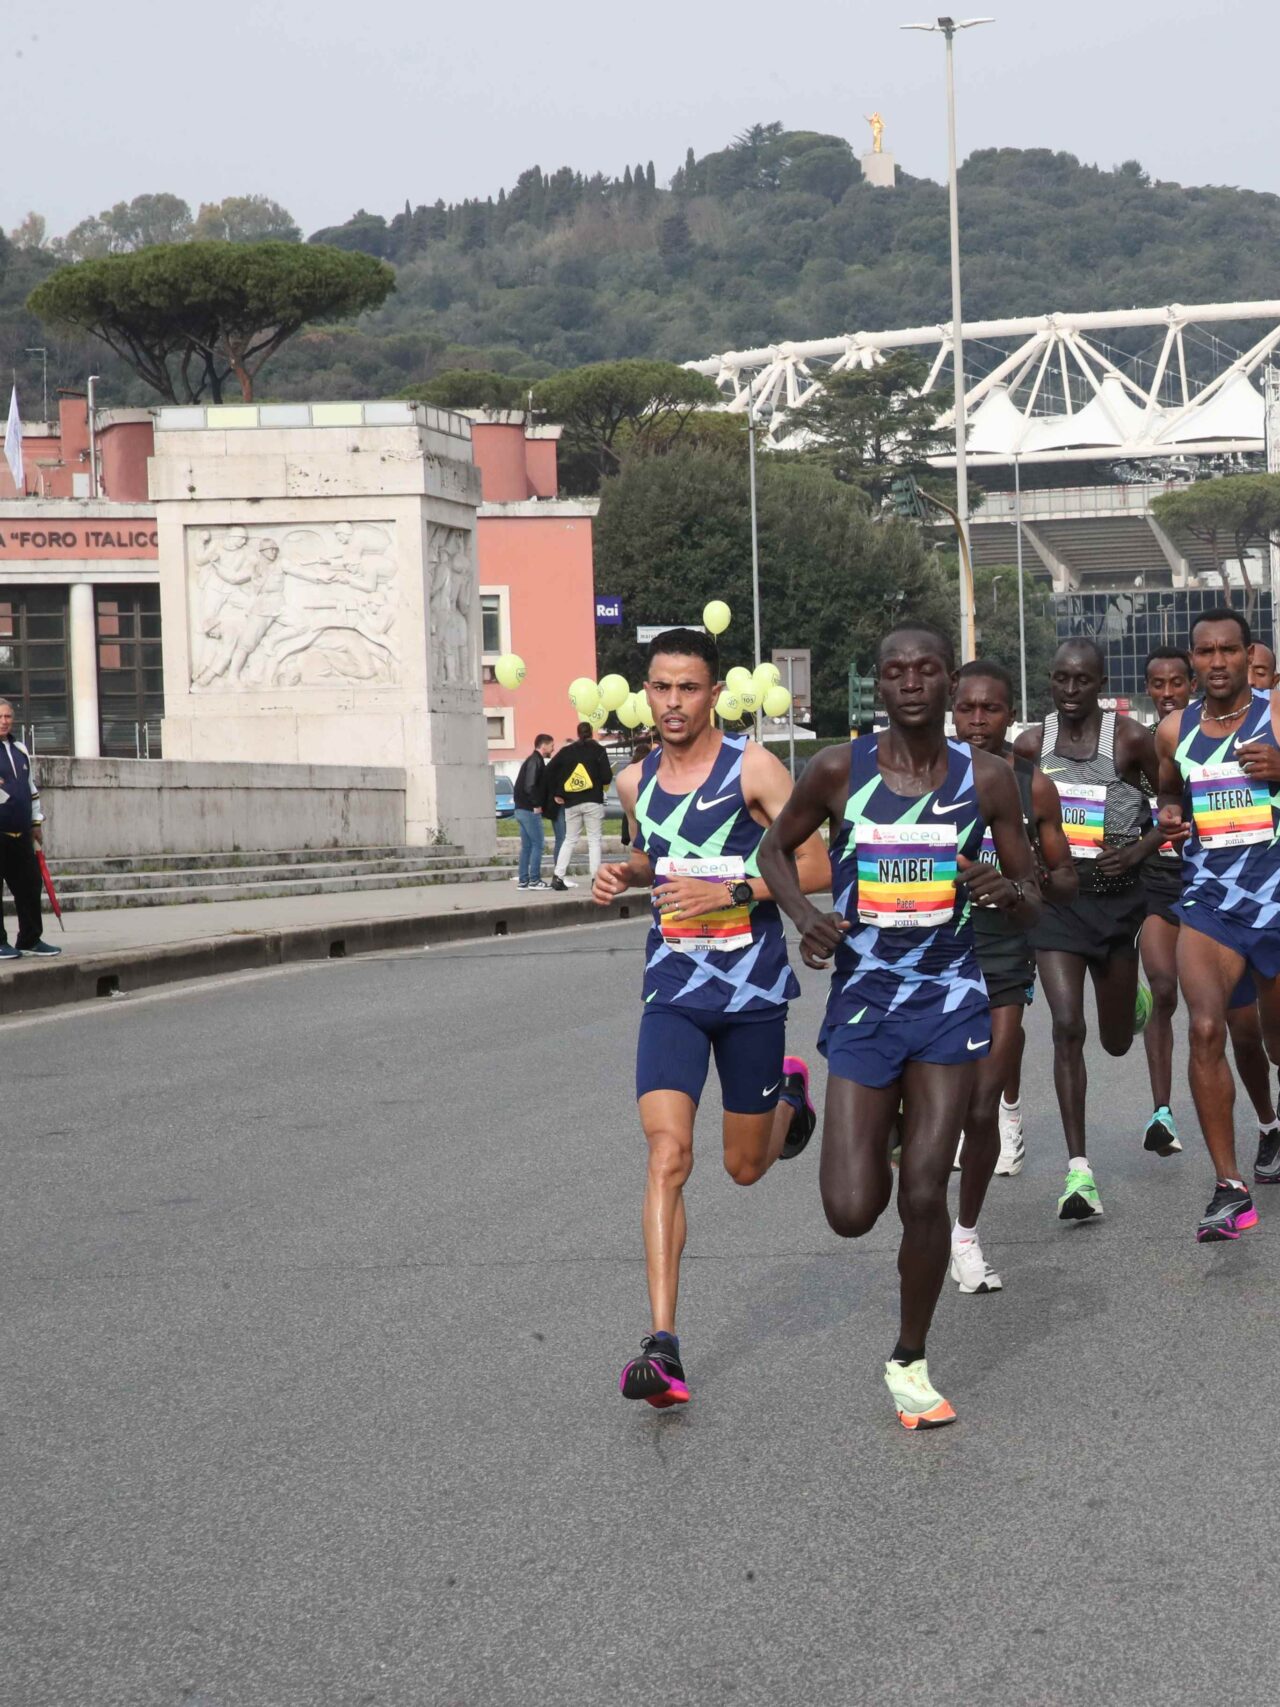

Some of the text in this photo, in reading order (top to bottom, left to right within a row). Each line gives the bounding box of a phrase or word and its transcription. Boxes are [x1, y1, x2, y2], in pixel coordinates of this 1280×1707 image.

[596, 603, 619, 617] Rai
[571, 777, 585, 787] 105
[1206, 788, 1254, 811] TEFERA
[899, 831, 941, 841] acea
[691, 863, 728, 875] acea
[878, 858, 934, 883] NAIBEI
[896, 898, 915, 909] Pacer
